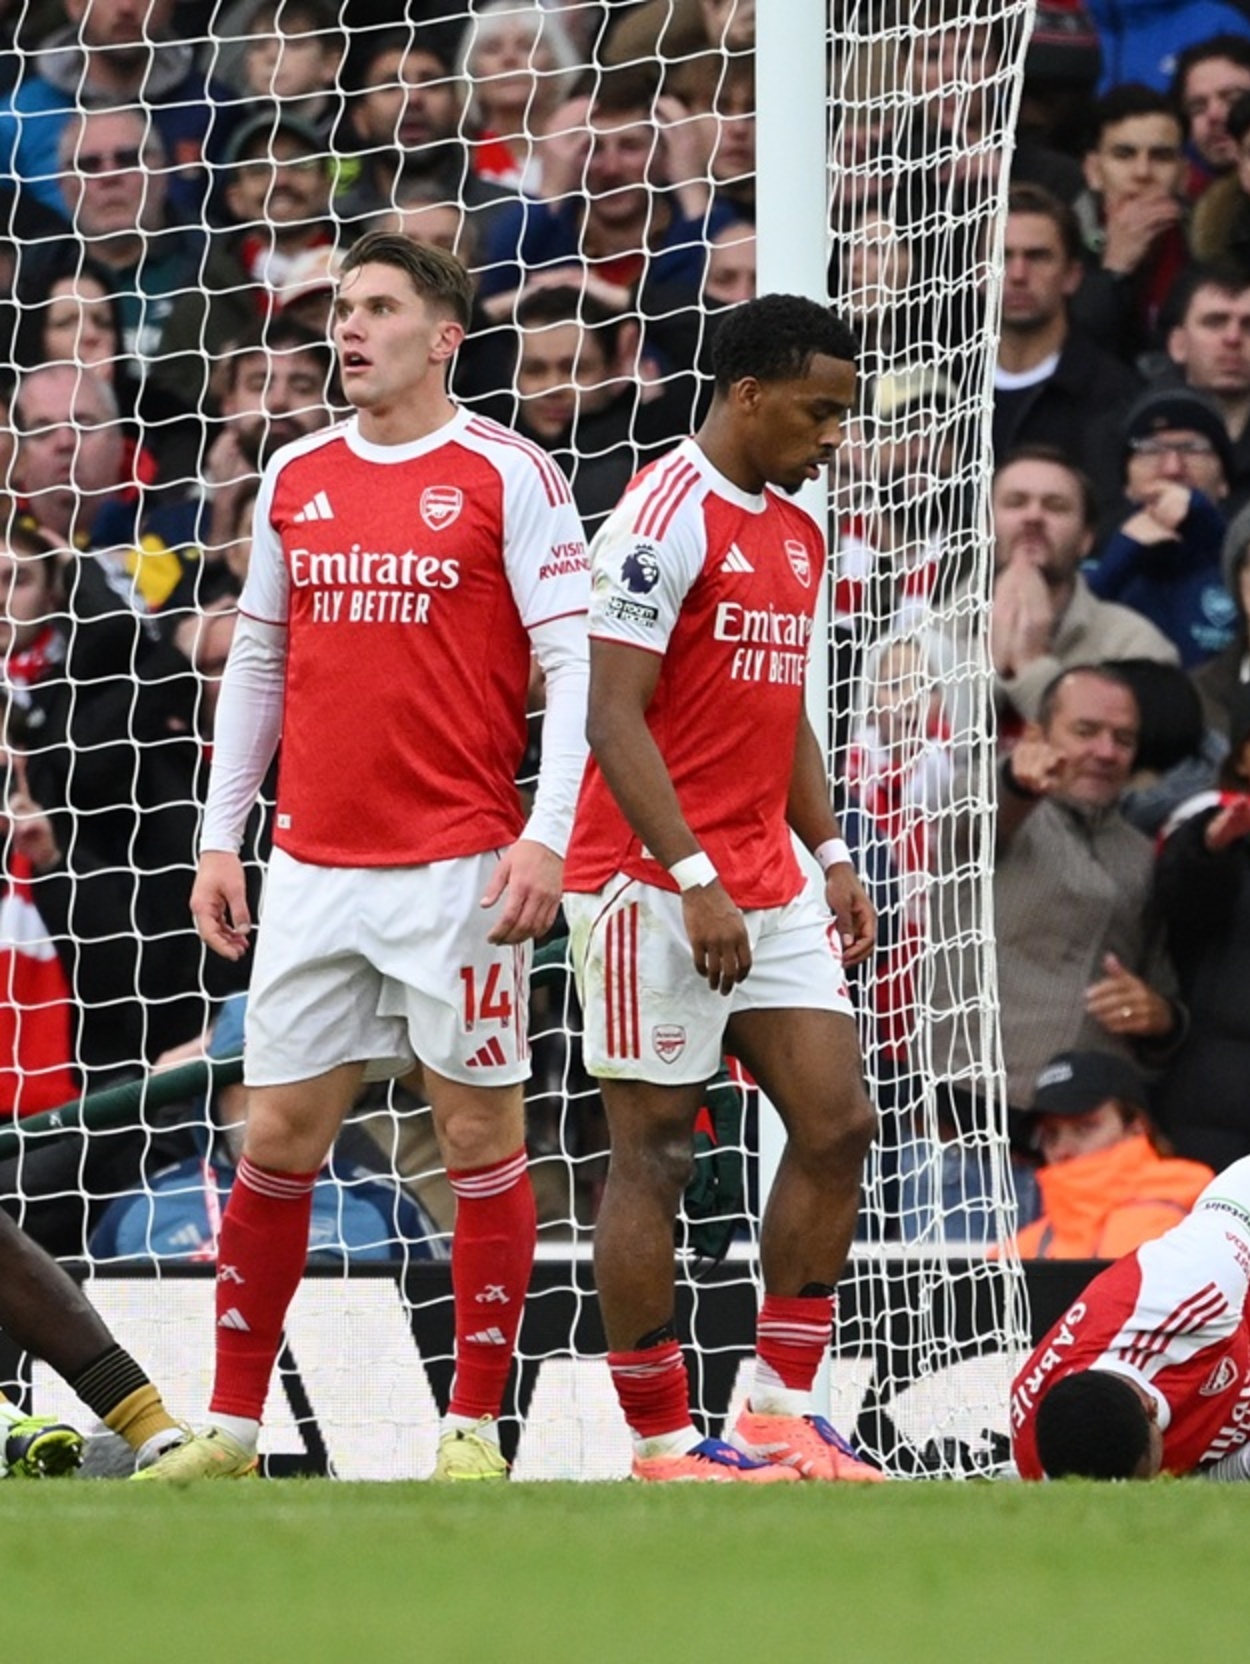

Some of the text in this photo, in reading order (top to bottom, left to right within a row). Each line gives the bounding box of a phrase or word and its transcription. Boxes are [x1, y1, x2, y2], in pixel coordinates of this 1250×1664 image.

[290, 544, 460, 589] Emirates
[540, 557, 591, 581] RWAN
[313, 590, 430, 624] FLY BETTER
[731, 648, 805, 687] FLY BETTE
[460, 963, 512, 1032] 14
[1010, 1300, 1088, 1438] GABRIE
